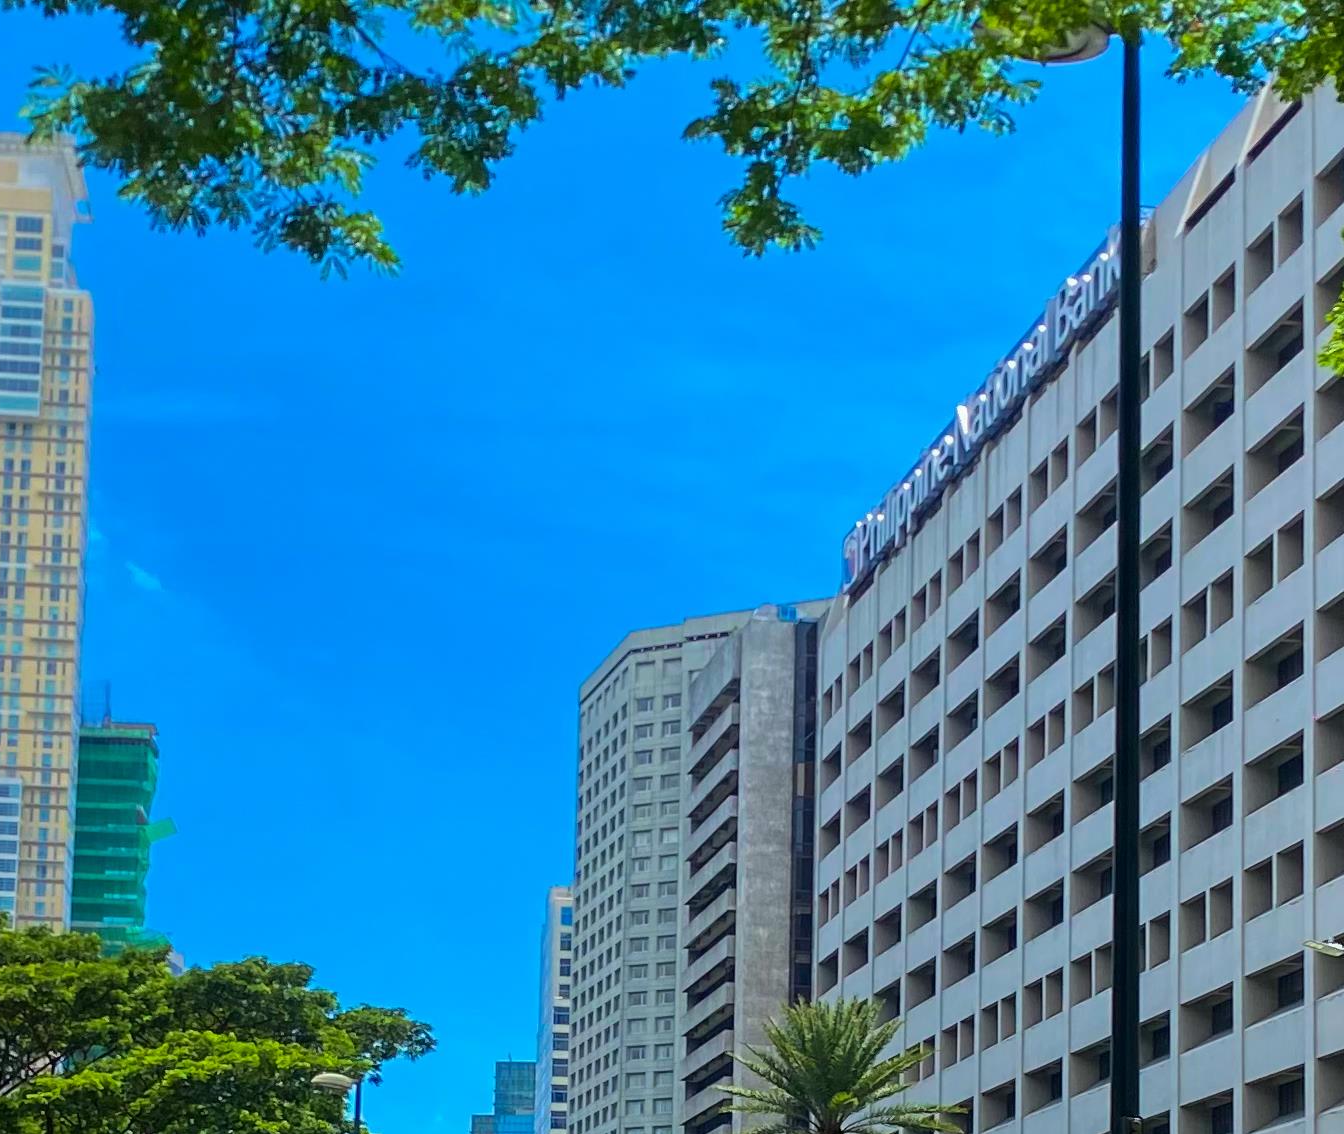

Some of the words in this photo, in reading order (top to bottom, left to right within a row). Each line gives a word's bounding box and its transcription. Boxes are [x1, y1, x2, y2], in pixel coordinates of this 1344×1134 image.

[858, 437, 954, 572] Philippine
[954, 300, 1052, 464] National
[1054, 222, 1121, 352] Bank
